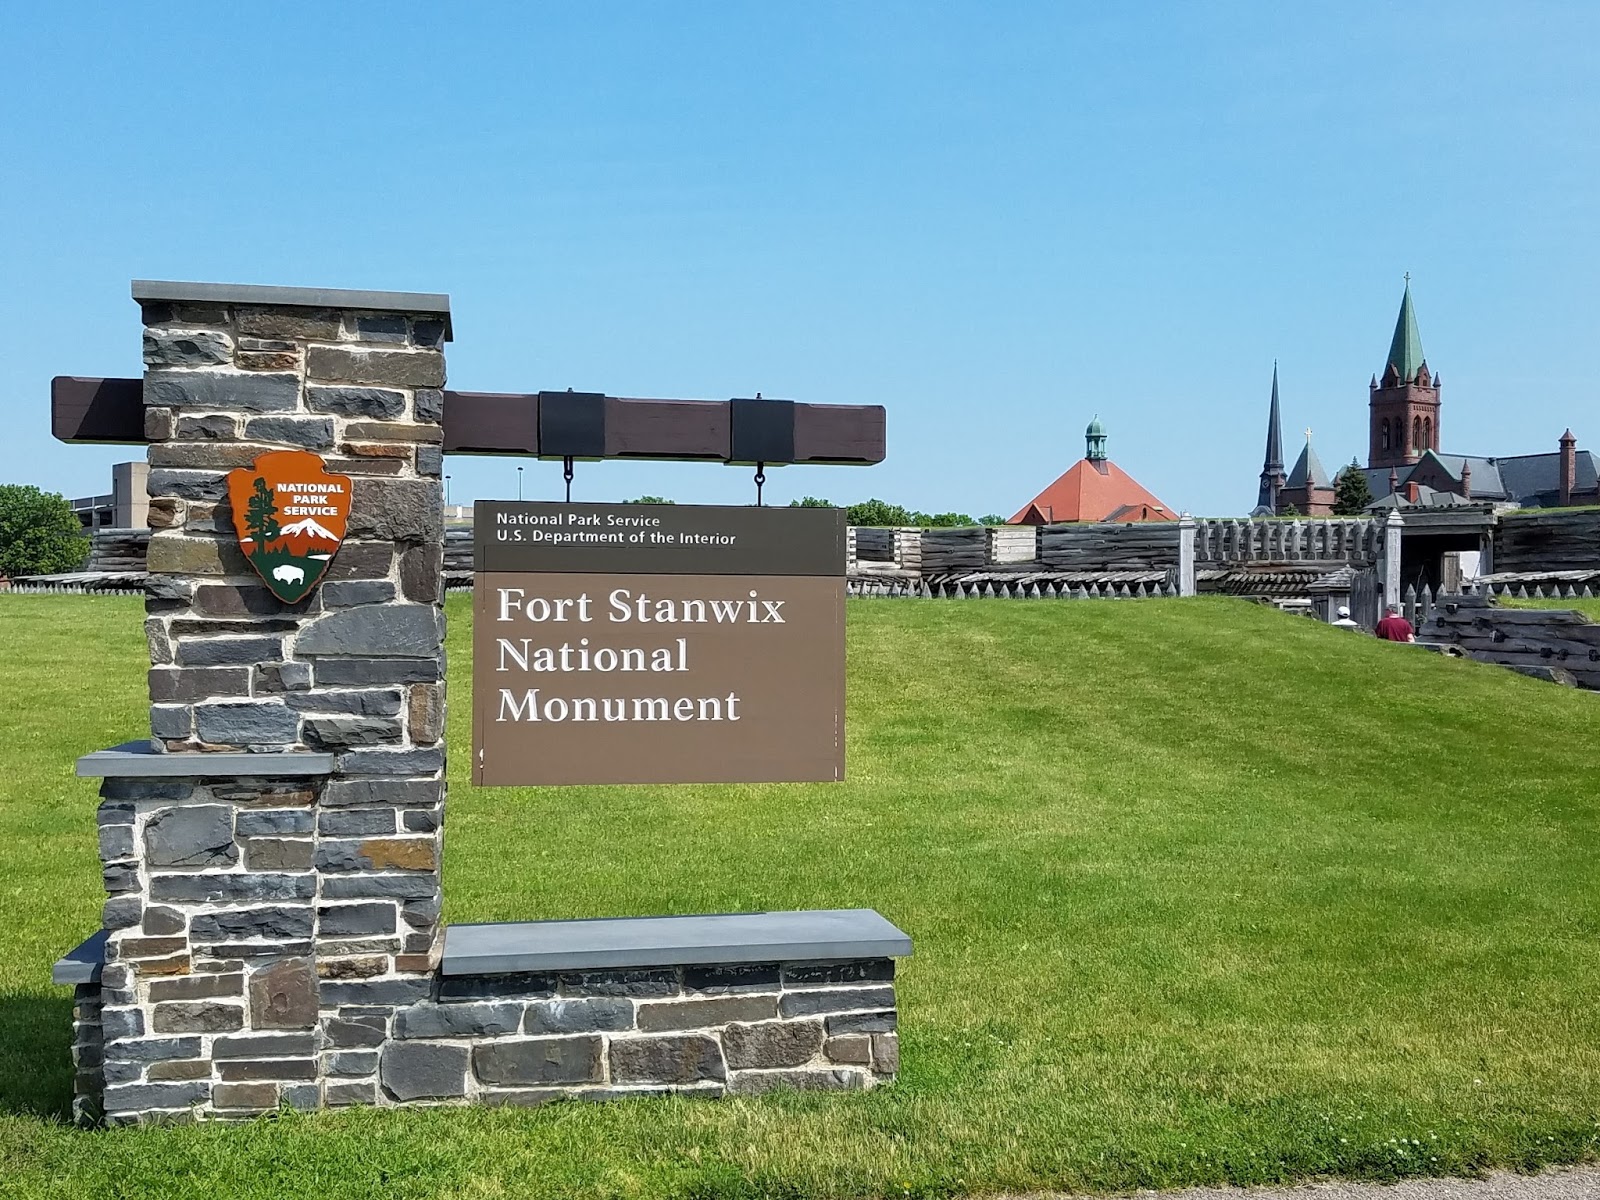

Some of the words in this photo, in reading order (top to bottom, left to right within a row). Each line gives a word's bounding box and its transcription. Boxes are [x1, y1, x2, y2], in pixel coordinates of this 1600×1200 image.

[277, 483, 344, 493] NATIONAL
[293, 495, 328, 504] PARK
[283, 506, 338, 516] SERVICE
[496, 512, 563, 526] National
[568, 513, 601, 527] Park
[606, 514, 661, 527] Service
[496, 529, 527, 542] U.S.
[533, 530, 625, 545] Department
[629, 531, 646, 544] of
[650, 531, 675, 544] the
[680, 532, 736, 545] Interior
[496, 588, 593, 622] Fort
[608, 588, 786, 623] Stanwix
[496, 638, 690, 672] National
[495, 688, 741, 722] Monument
